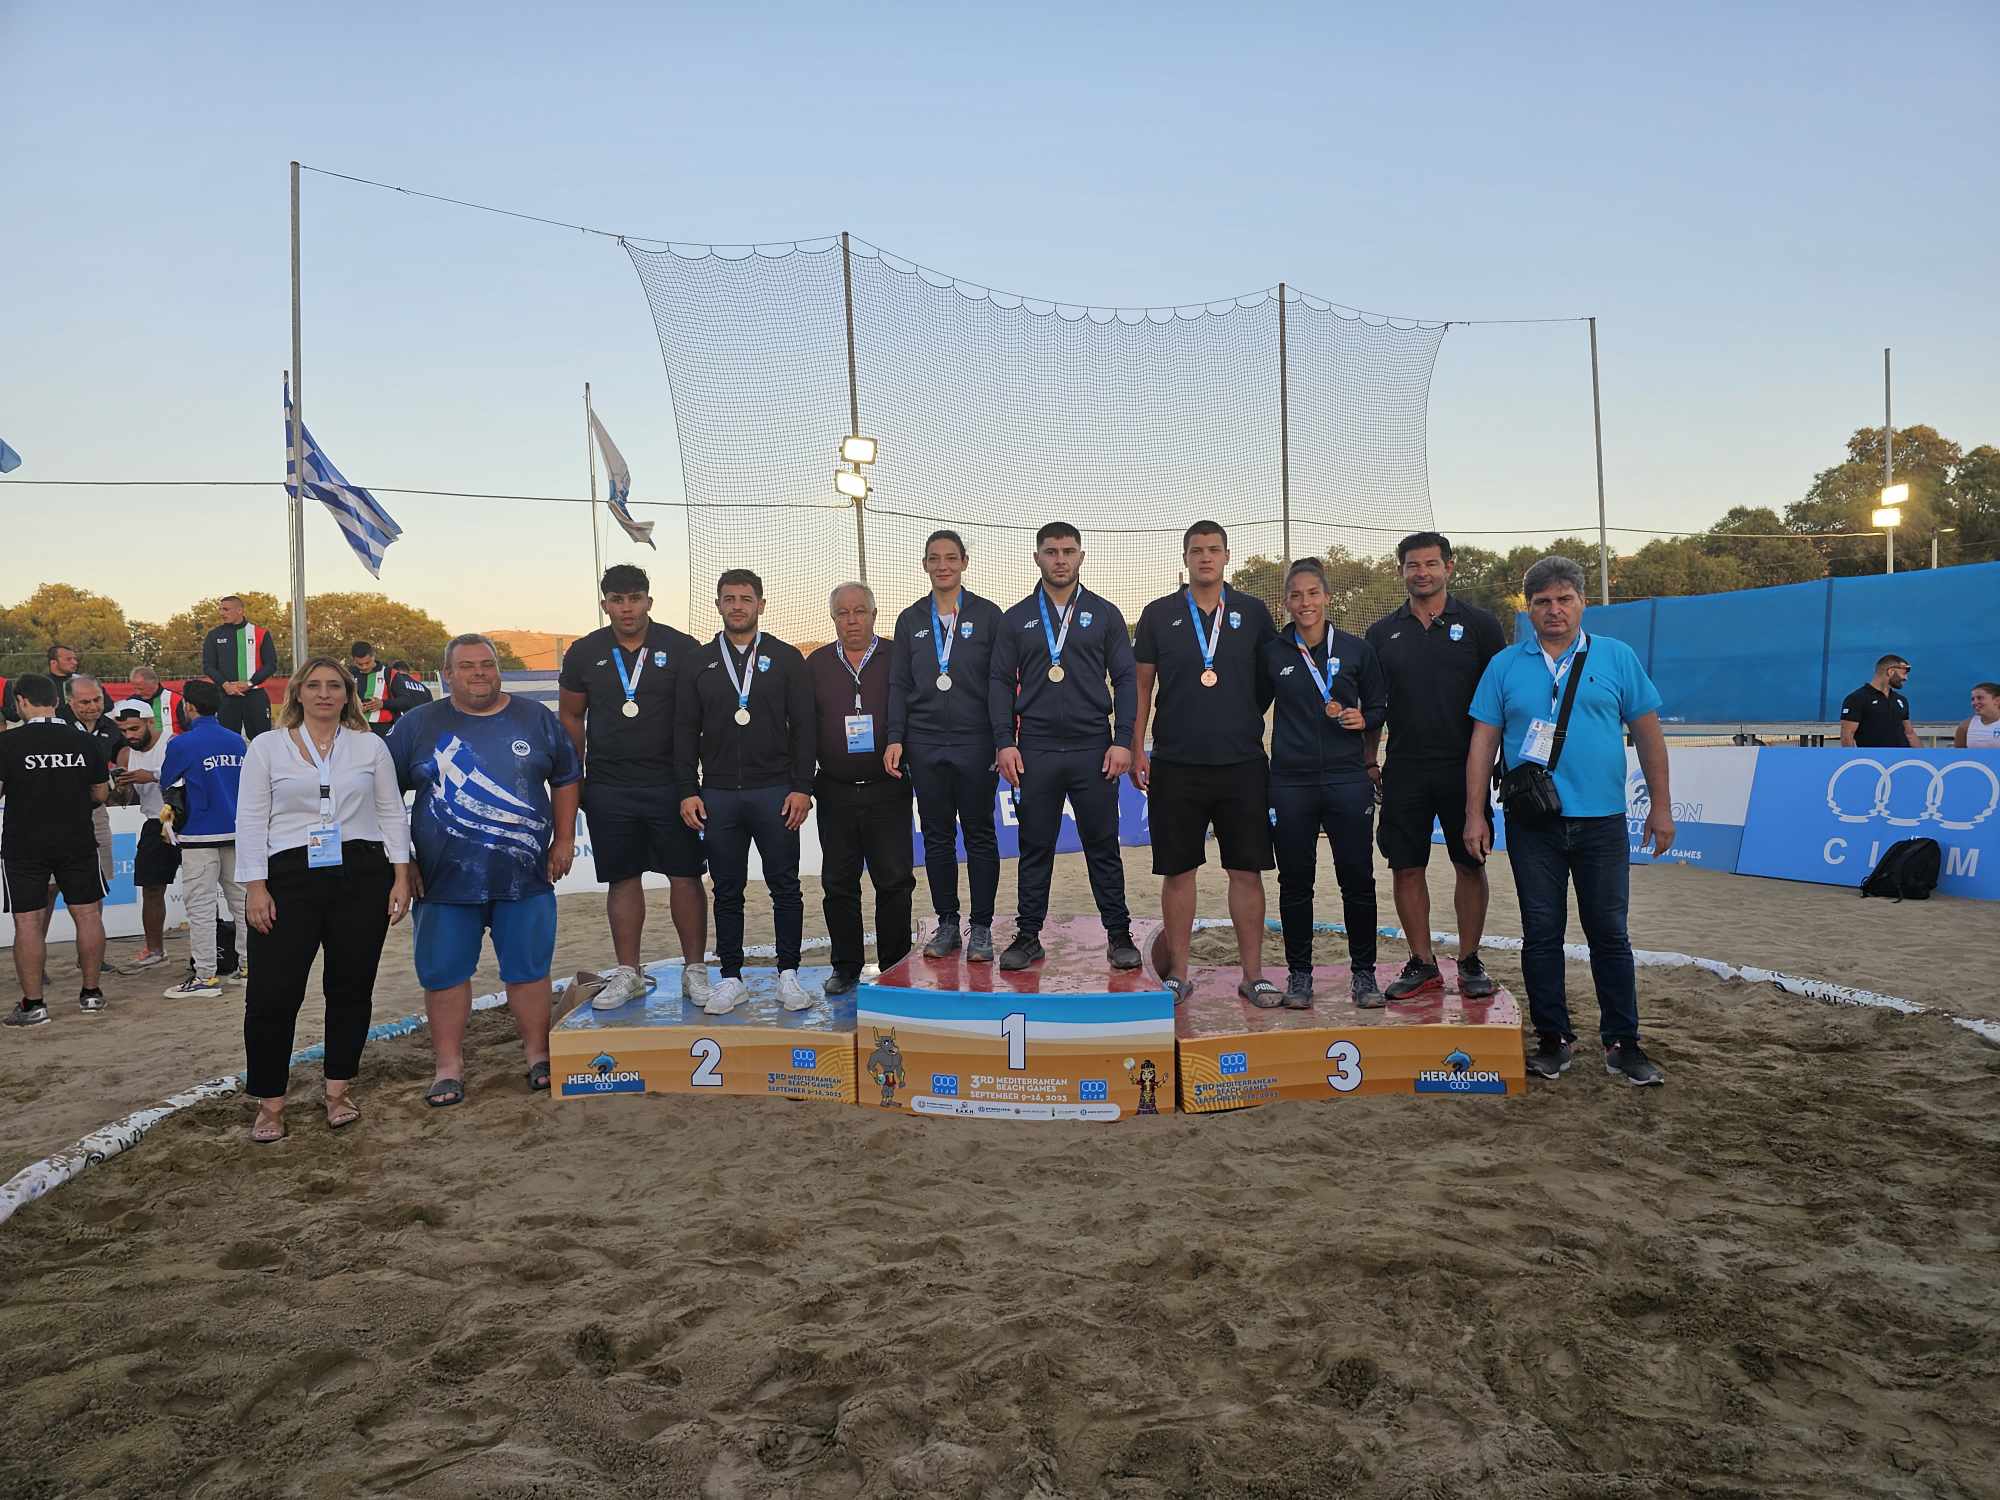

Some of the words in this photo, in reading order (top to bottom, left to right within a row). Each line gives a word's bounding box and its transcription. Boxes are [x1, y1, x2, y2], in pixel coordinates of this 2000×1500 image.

[24, 753, 87, 770] SYRIA
[1672, 848, 1703, 860] GAMES
[1001, 1012, 1026, 1071] 1
[690, 1037, 724, 1087] 2
[1326, 1040, 1364, 1092] 3
[568, 1072, 640, 1085] HERAKLION
[970, 1074, 994, 1089] 3RD
[996, 1076, 1068, 1087] MEDITERRANEAN
[1420, 1072, 1500, 1082] HERAKLION
[996, 1083, 1026, 1092] BEACH
[1026, 1084, 1057, 1093] GAMES
[970, 1091, 1020, 1101] SEPTEMBER
